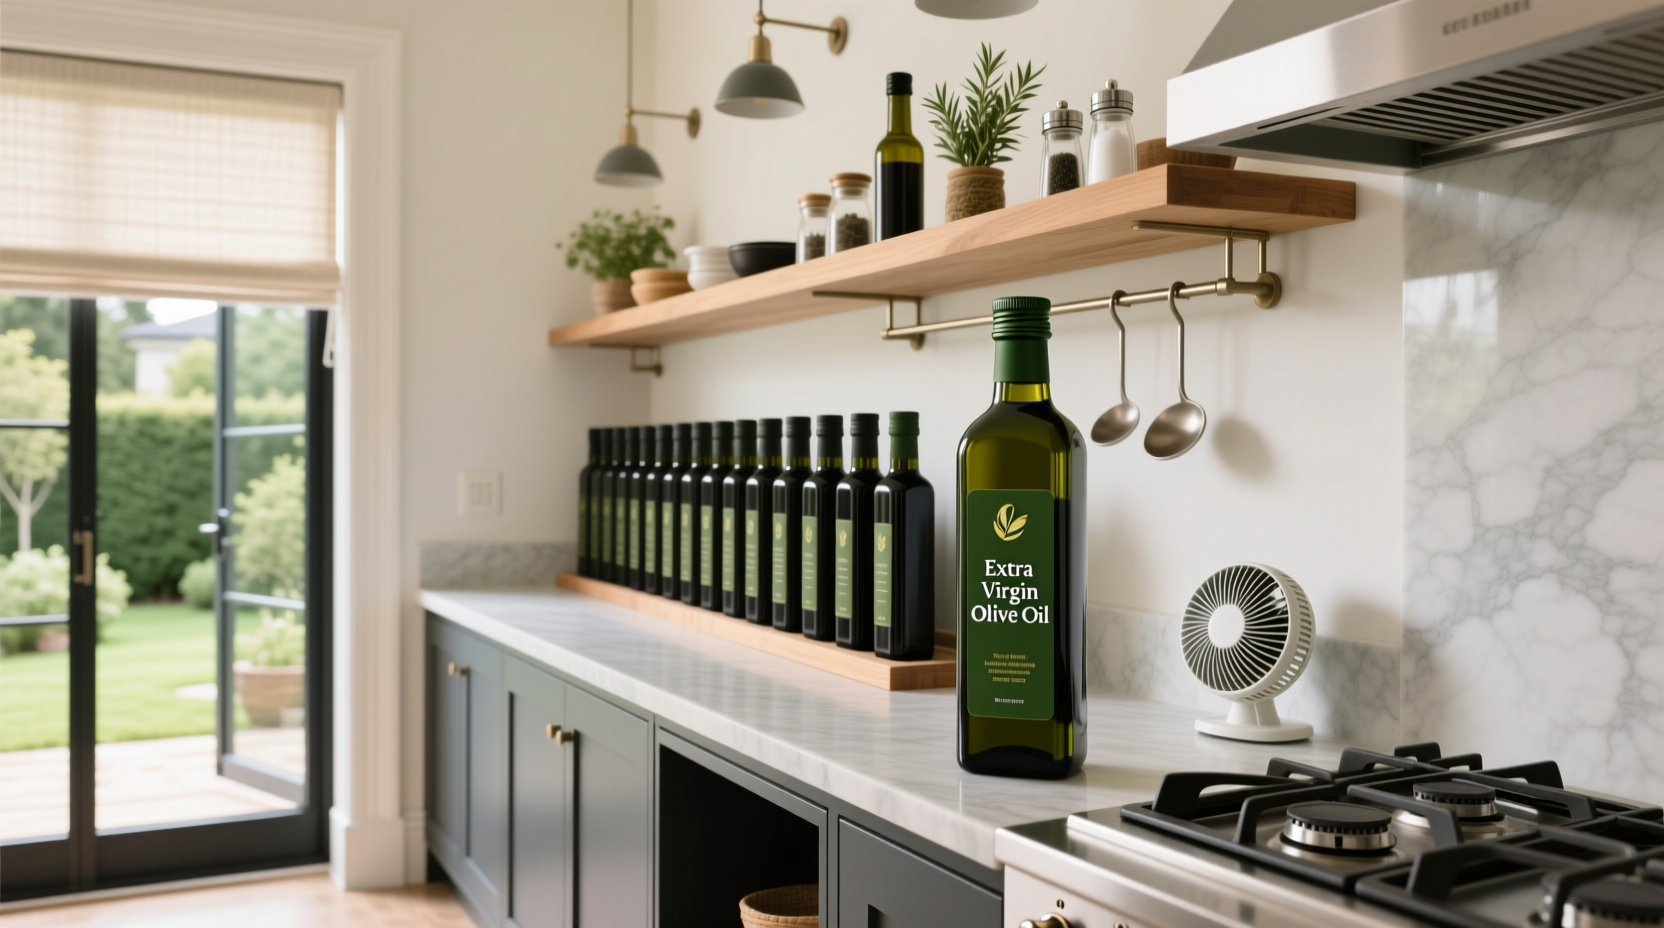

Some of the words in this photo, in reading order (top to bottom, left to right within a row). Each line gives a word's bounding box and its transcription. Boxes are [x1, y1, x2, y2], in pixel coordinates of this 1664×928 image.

[984, 559, 1034, 577] Extra
[981, 581, 1039, 605] Virgin
[970, 604, 1018, 624] Olive
[1021, 605, 1049, 624] Oil
